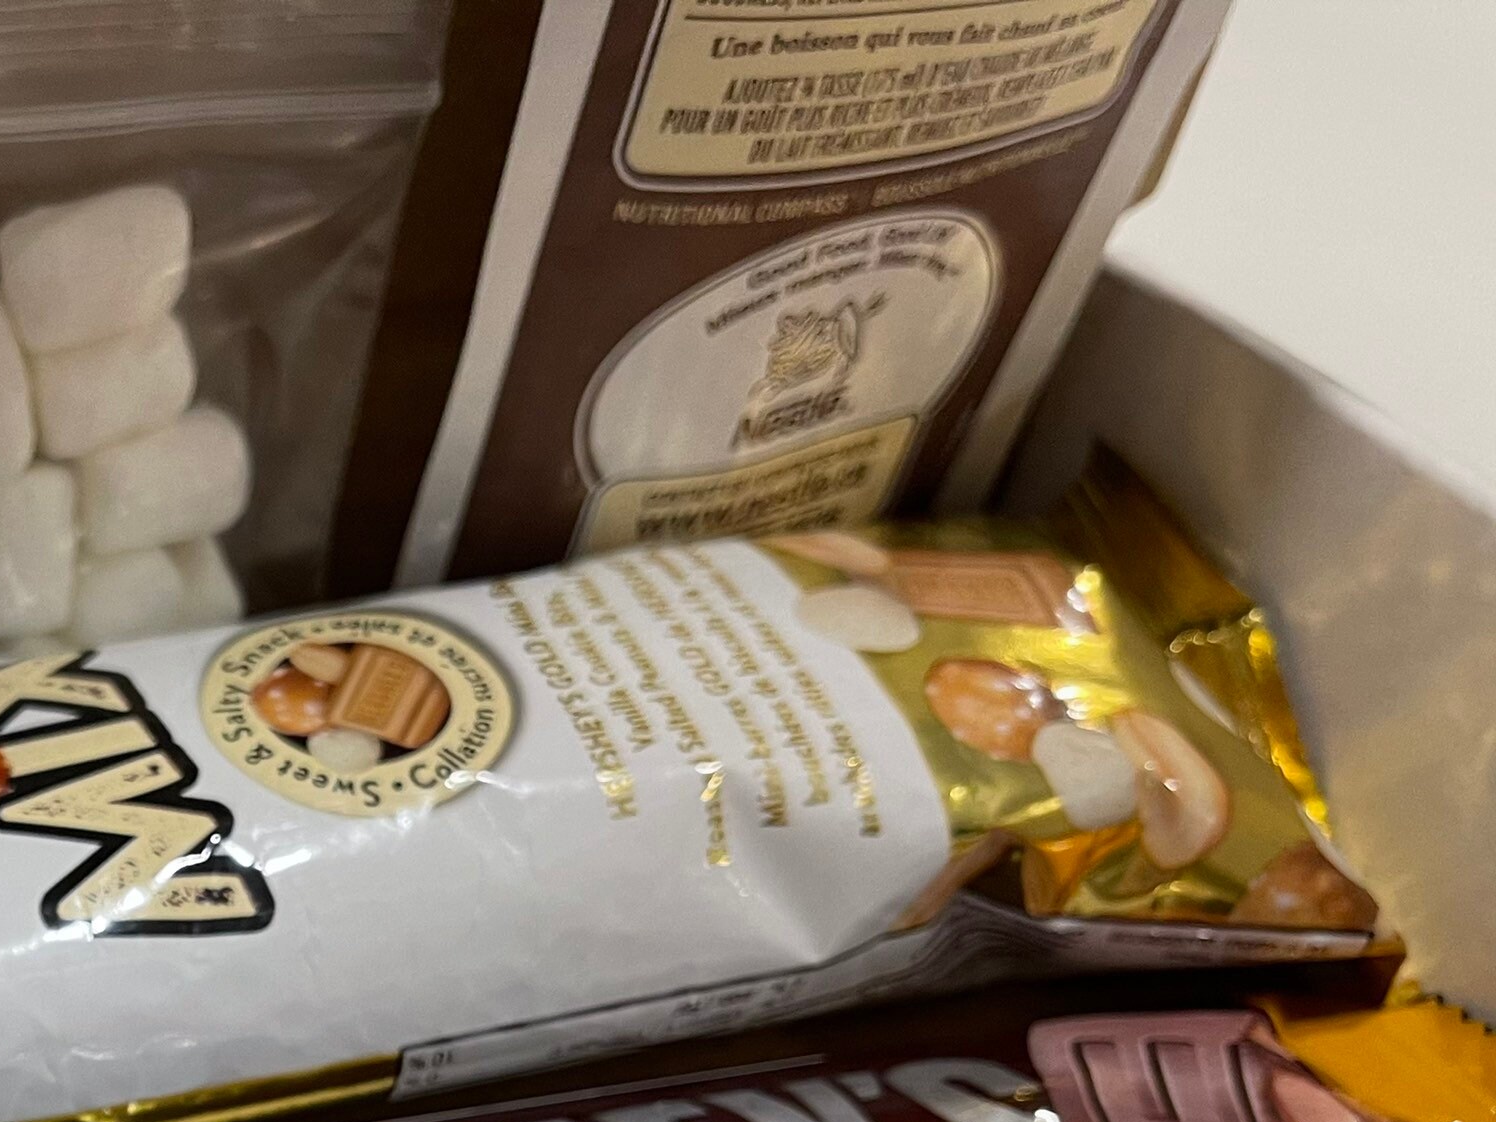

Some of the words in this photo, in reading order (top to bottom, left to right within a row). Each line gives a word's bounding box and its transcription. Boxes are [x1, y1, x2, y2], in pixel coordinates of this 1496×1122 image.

[711, 36, 764, 58] Une
[222, 628, 302, 677] Snack
[522, 638, 575, 691] GOLD
[678, 645, 731, 696] GOLD
[212, 684, 252, 743] Salty
[607, 687, 654, 753] Vanilla
[244, 744, 273, 766] &
[409, 707, 495, 790] Collation
[278, 759, 382, 808] Sweet
